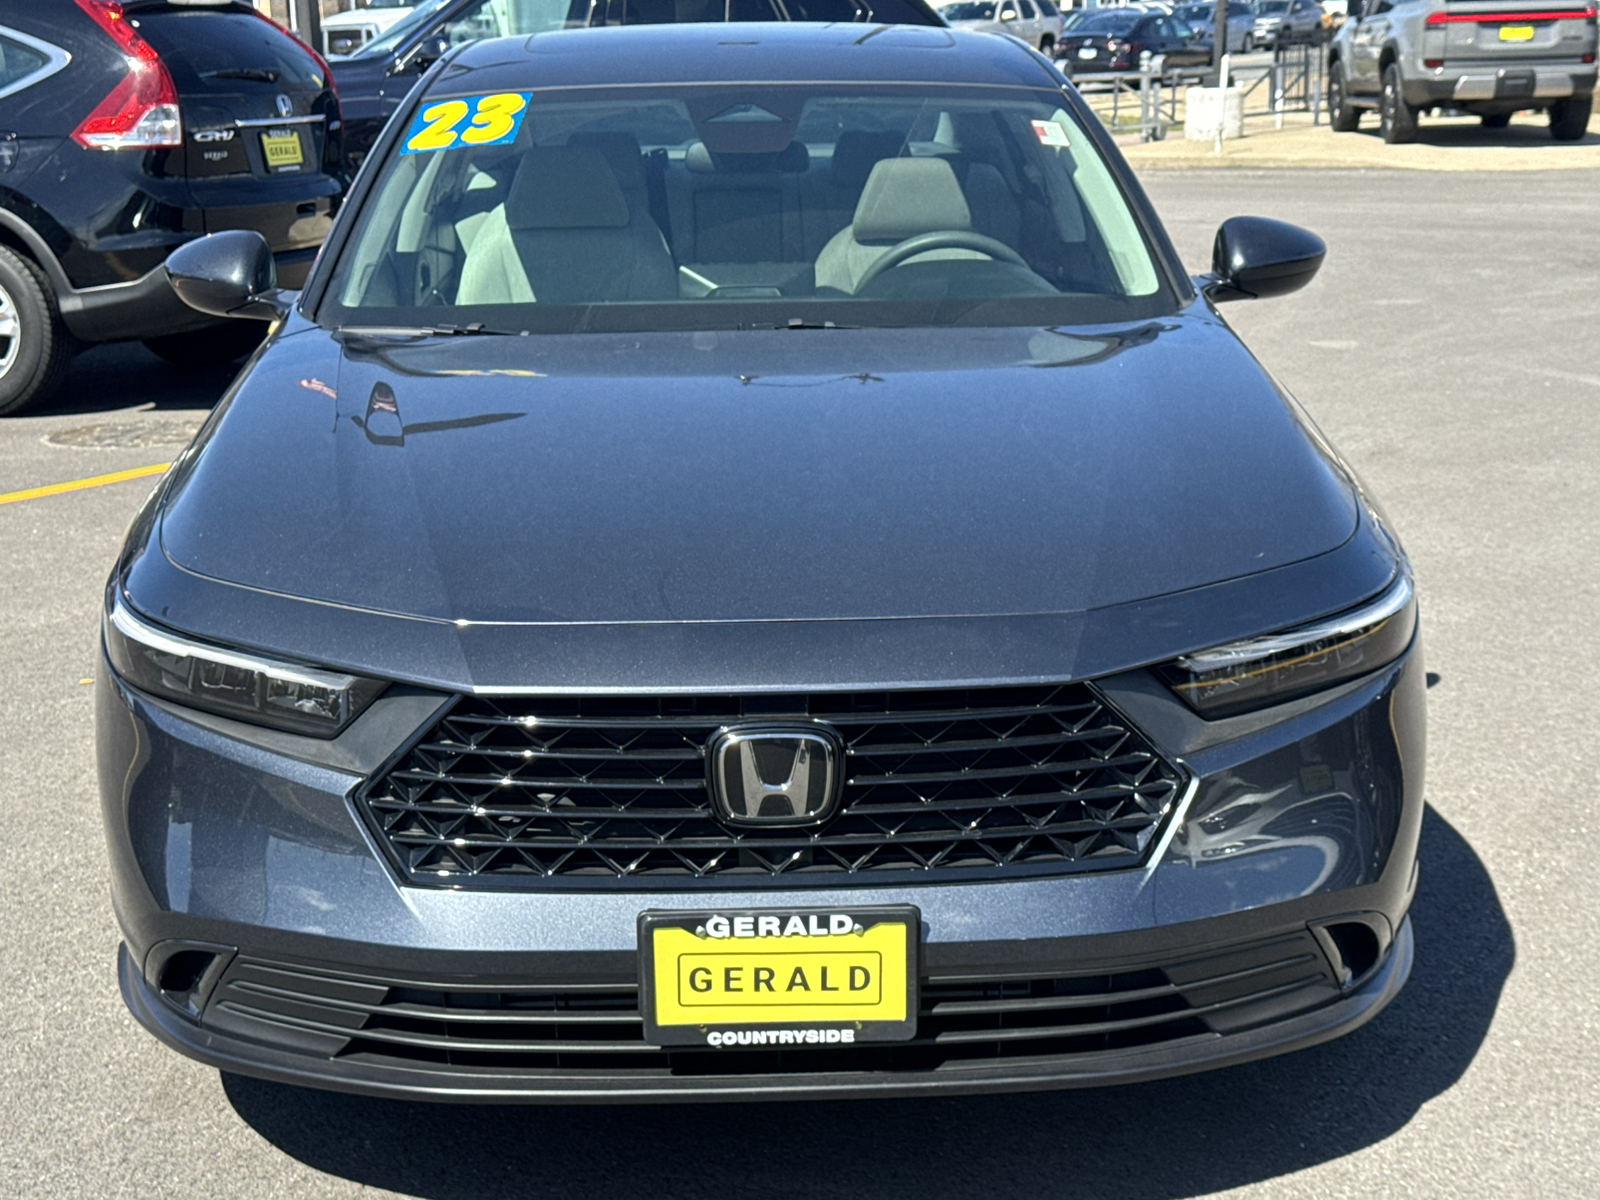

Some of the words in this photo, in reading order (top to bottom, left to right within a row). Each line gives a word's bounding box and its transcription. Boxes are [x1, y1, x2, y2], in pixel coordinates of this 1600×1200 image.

[407, 93, 526, 150] 23
[269, 146, 297, 157] GERALD
[705, 914, 853, 938] GERALD
[689, 966, 871, 992] GERALD
[707, 1029, 855, 1046] COUNTRYSIDE
